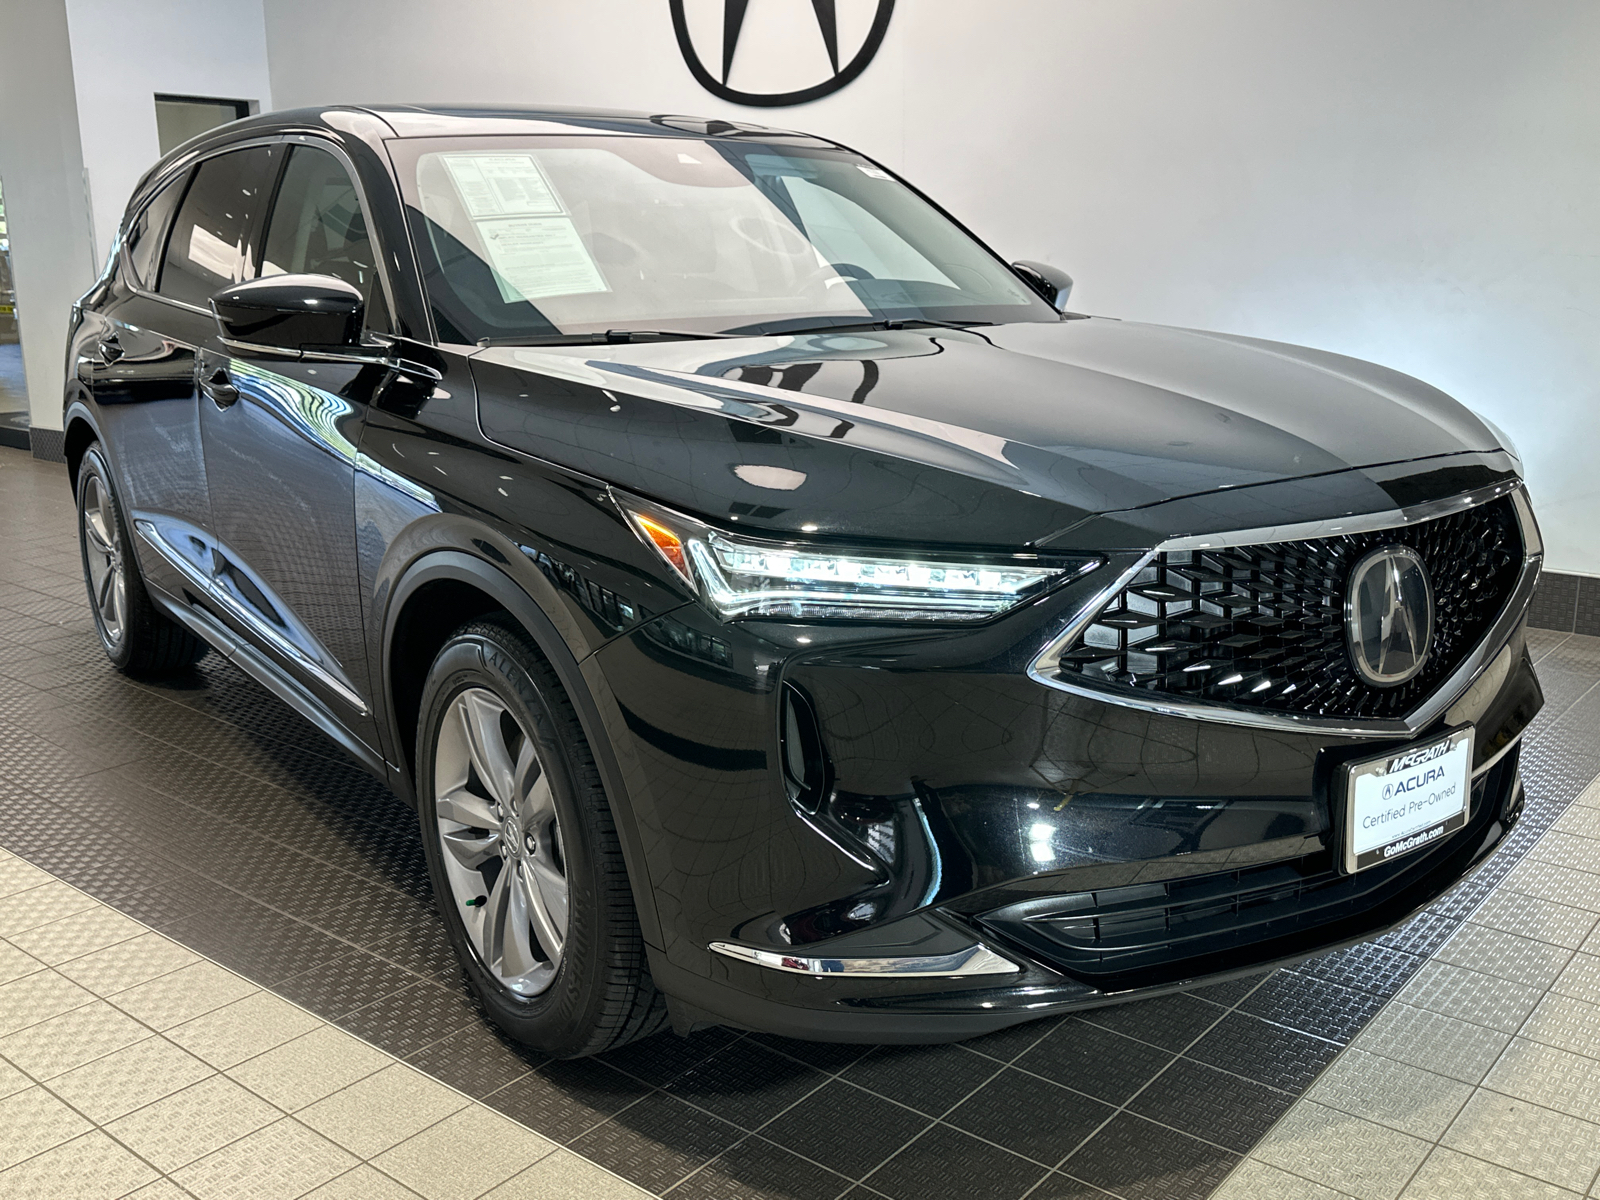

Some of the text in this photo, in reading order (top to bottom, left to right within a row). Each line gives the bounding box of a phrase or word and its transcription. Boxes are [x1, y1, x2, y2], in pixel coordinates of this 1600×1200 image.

[489, 652, 543, 726] ALENZA
[1394, 765, 1445, 796] ACURA
[1362, 782, 1456, 829] Certified Pre-Owned
[1383, 826, 1444, 857] GoMcGrath.com
